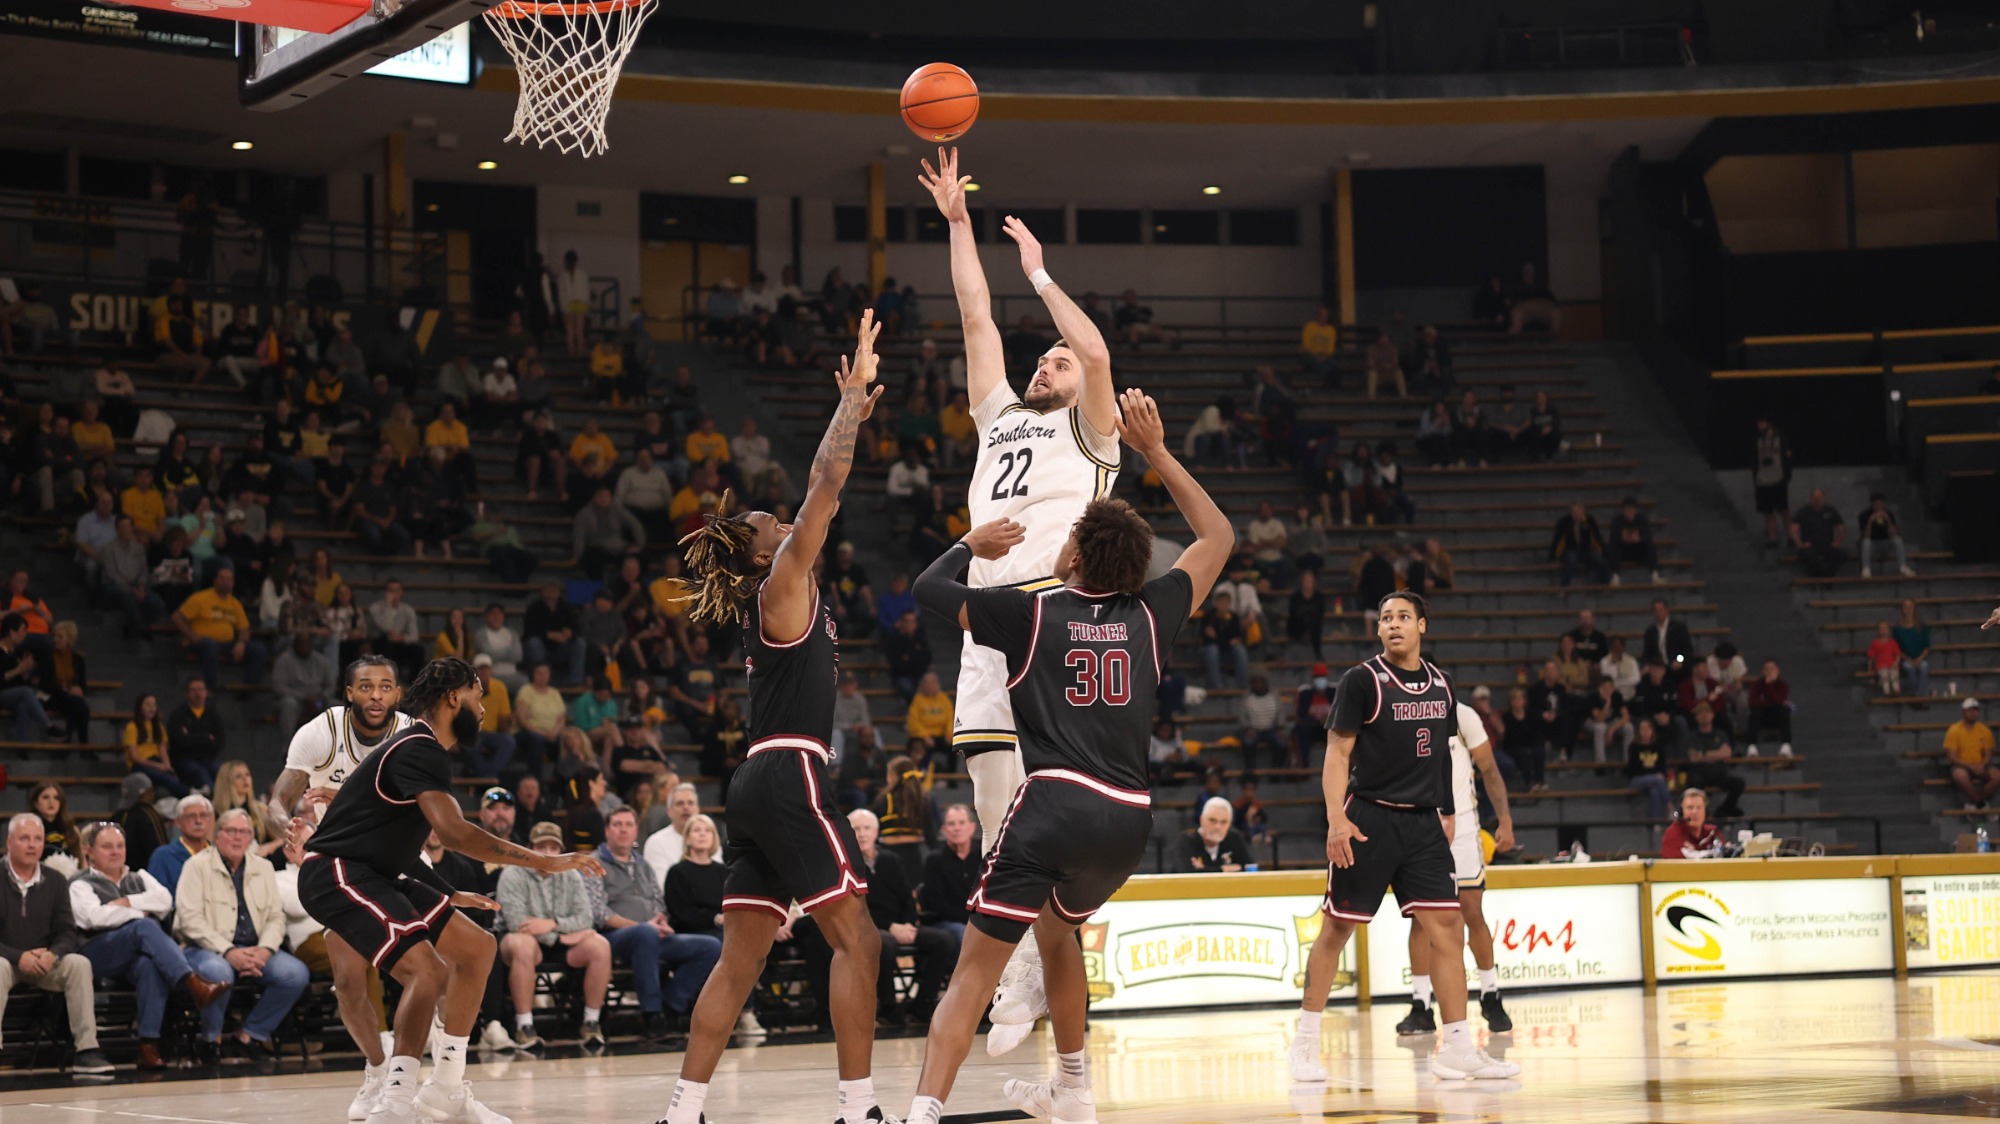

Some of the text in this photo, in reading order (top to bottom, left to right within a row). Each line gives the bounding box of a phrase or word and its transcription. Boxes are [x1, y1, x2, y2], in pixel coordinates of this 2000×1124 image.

[80, 5, 139, 22] GENESIS
[987, 418, 1056, 449] Southern
[991, 447, 1033, 501] 22
[1067, 621, 1128, 641] TURNER
[1065, 648, 1131, 706] 30
[1392, 701, 1446, 720] TROJANS
[1416, 728, 1431, 757] 2
[1935, 897, 2000, 924] SOUTHE
[1129, 939, 1169, 972] KEG
[1196, 935, 1275, 966] BARREL
[1576, 958, 1606, 975] Inc.
